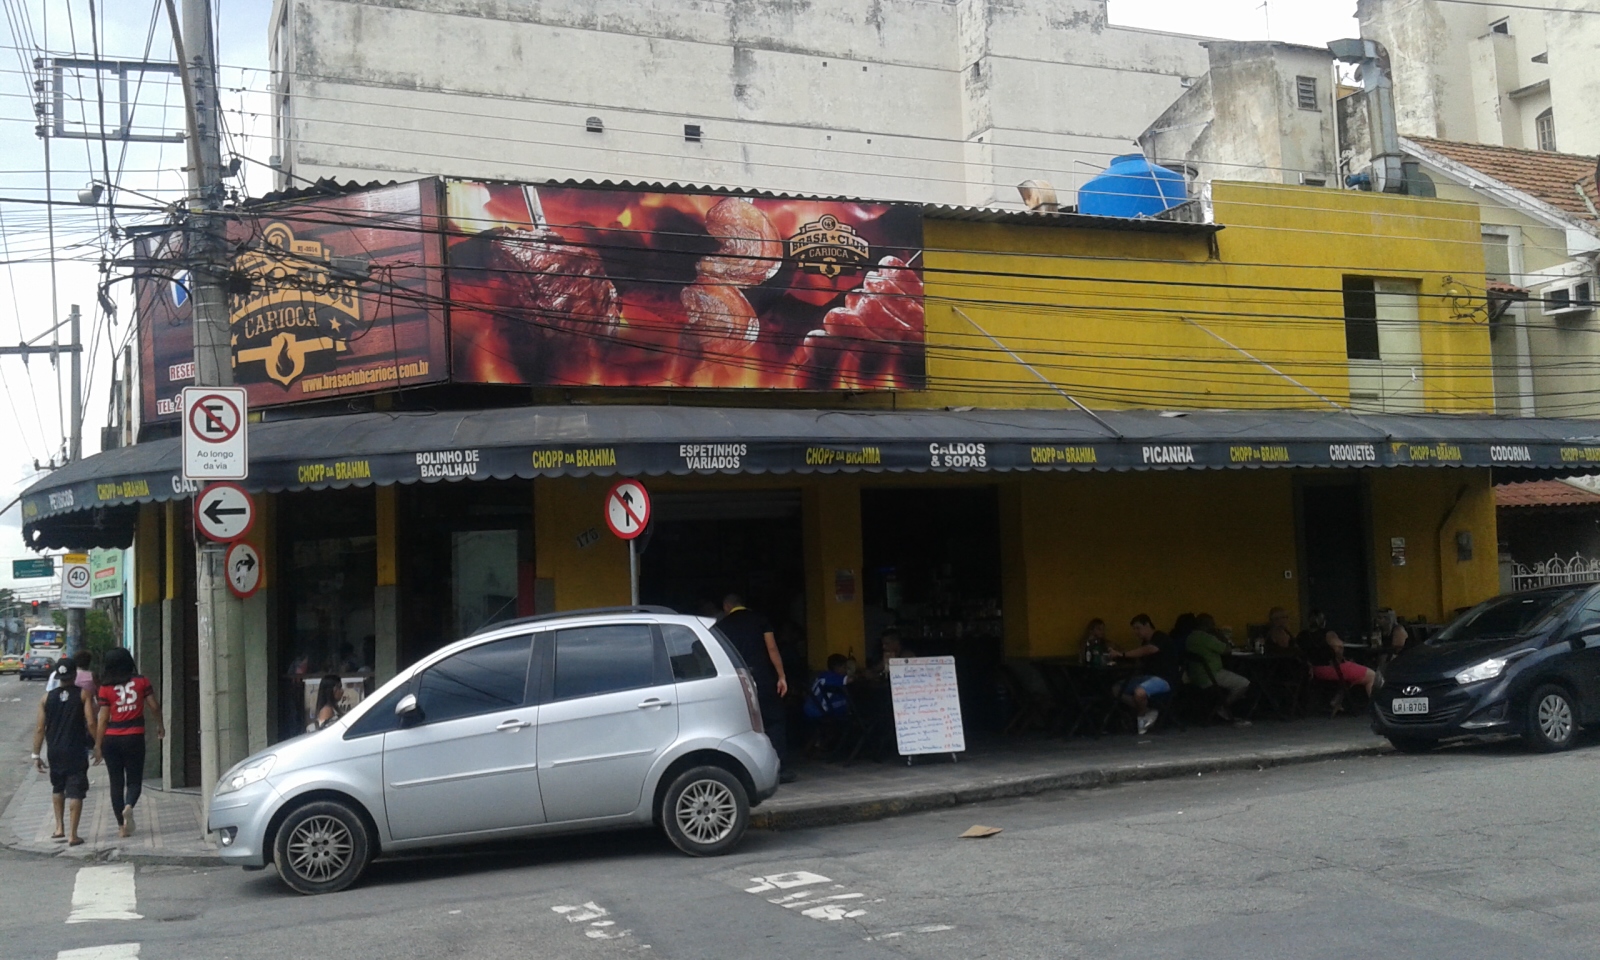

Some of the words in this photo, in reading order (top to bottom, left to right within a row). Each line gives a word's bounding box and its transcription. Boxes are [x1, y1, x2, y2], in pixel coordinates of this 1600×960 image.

[792, 233, 828, 252] BRASA
[838, 234, 866, 254] CLUB
[809, 248, 848, 258] CARIOCA
[244, 307, 320, 339] CARIOCA
[169, 362, 196, 380] RESER
[302, 360, 429, 393] www.brasaclubcariocacom.br
[210, 450, 234, 459] longo
[680, 444, 747, 457] ESPETINHOS
[806, 448, 835, 465] CHOPP
[836, 450, 845, 461] DA
[930, 443, 986, 455] CALDOS
[1031, 447, 1056, 463] CHOPP
[1066, 447, 1096, 463] BRAHMA
[1142, 446, 1194, 464] PICANHA
[1230, 446, 1252, 462] CHOPP
[1261, 446, 1290, 462] BRAHMA
[1330, 444, 1376, 461] CROQUETES
[1410, 446, 1430, 460] CHOPP
[1436, 446, 1462, 461] BRAHMA
[1490, 446, 1531, 461] CODORNA
[1561, 448, 1578, 462] CHOPP
[416, 450, 463, 465] BOLINHO
[465, 450, 480, 462] DE
[532, 451, 564, 469] CHOPP
[565, 453, 575, 464] DA
[576, 448, 616, 468] BRAHMA
[686, 456, 740, 469] VARIADOS
[930, 455, 940, 467] &
[944, 455, 986, 468] SOPAS
[298, 464, 324, 483] CHOPP
[336, 460, 370, 480] BRAHMA
[420, 463, 477, 477] BACALHAU
[576, 528, 598, 547] 175
[72, 571, 86, 581] 40
[114, 681, 138, 706] 35
